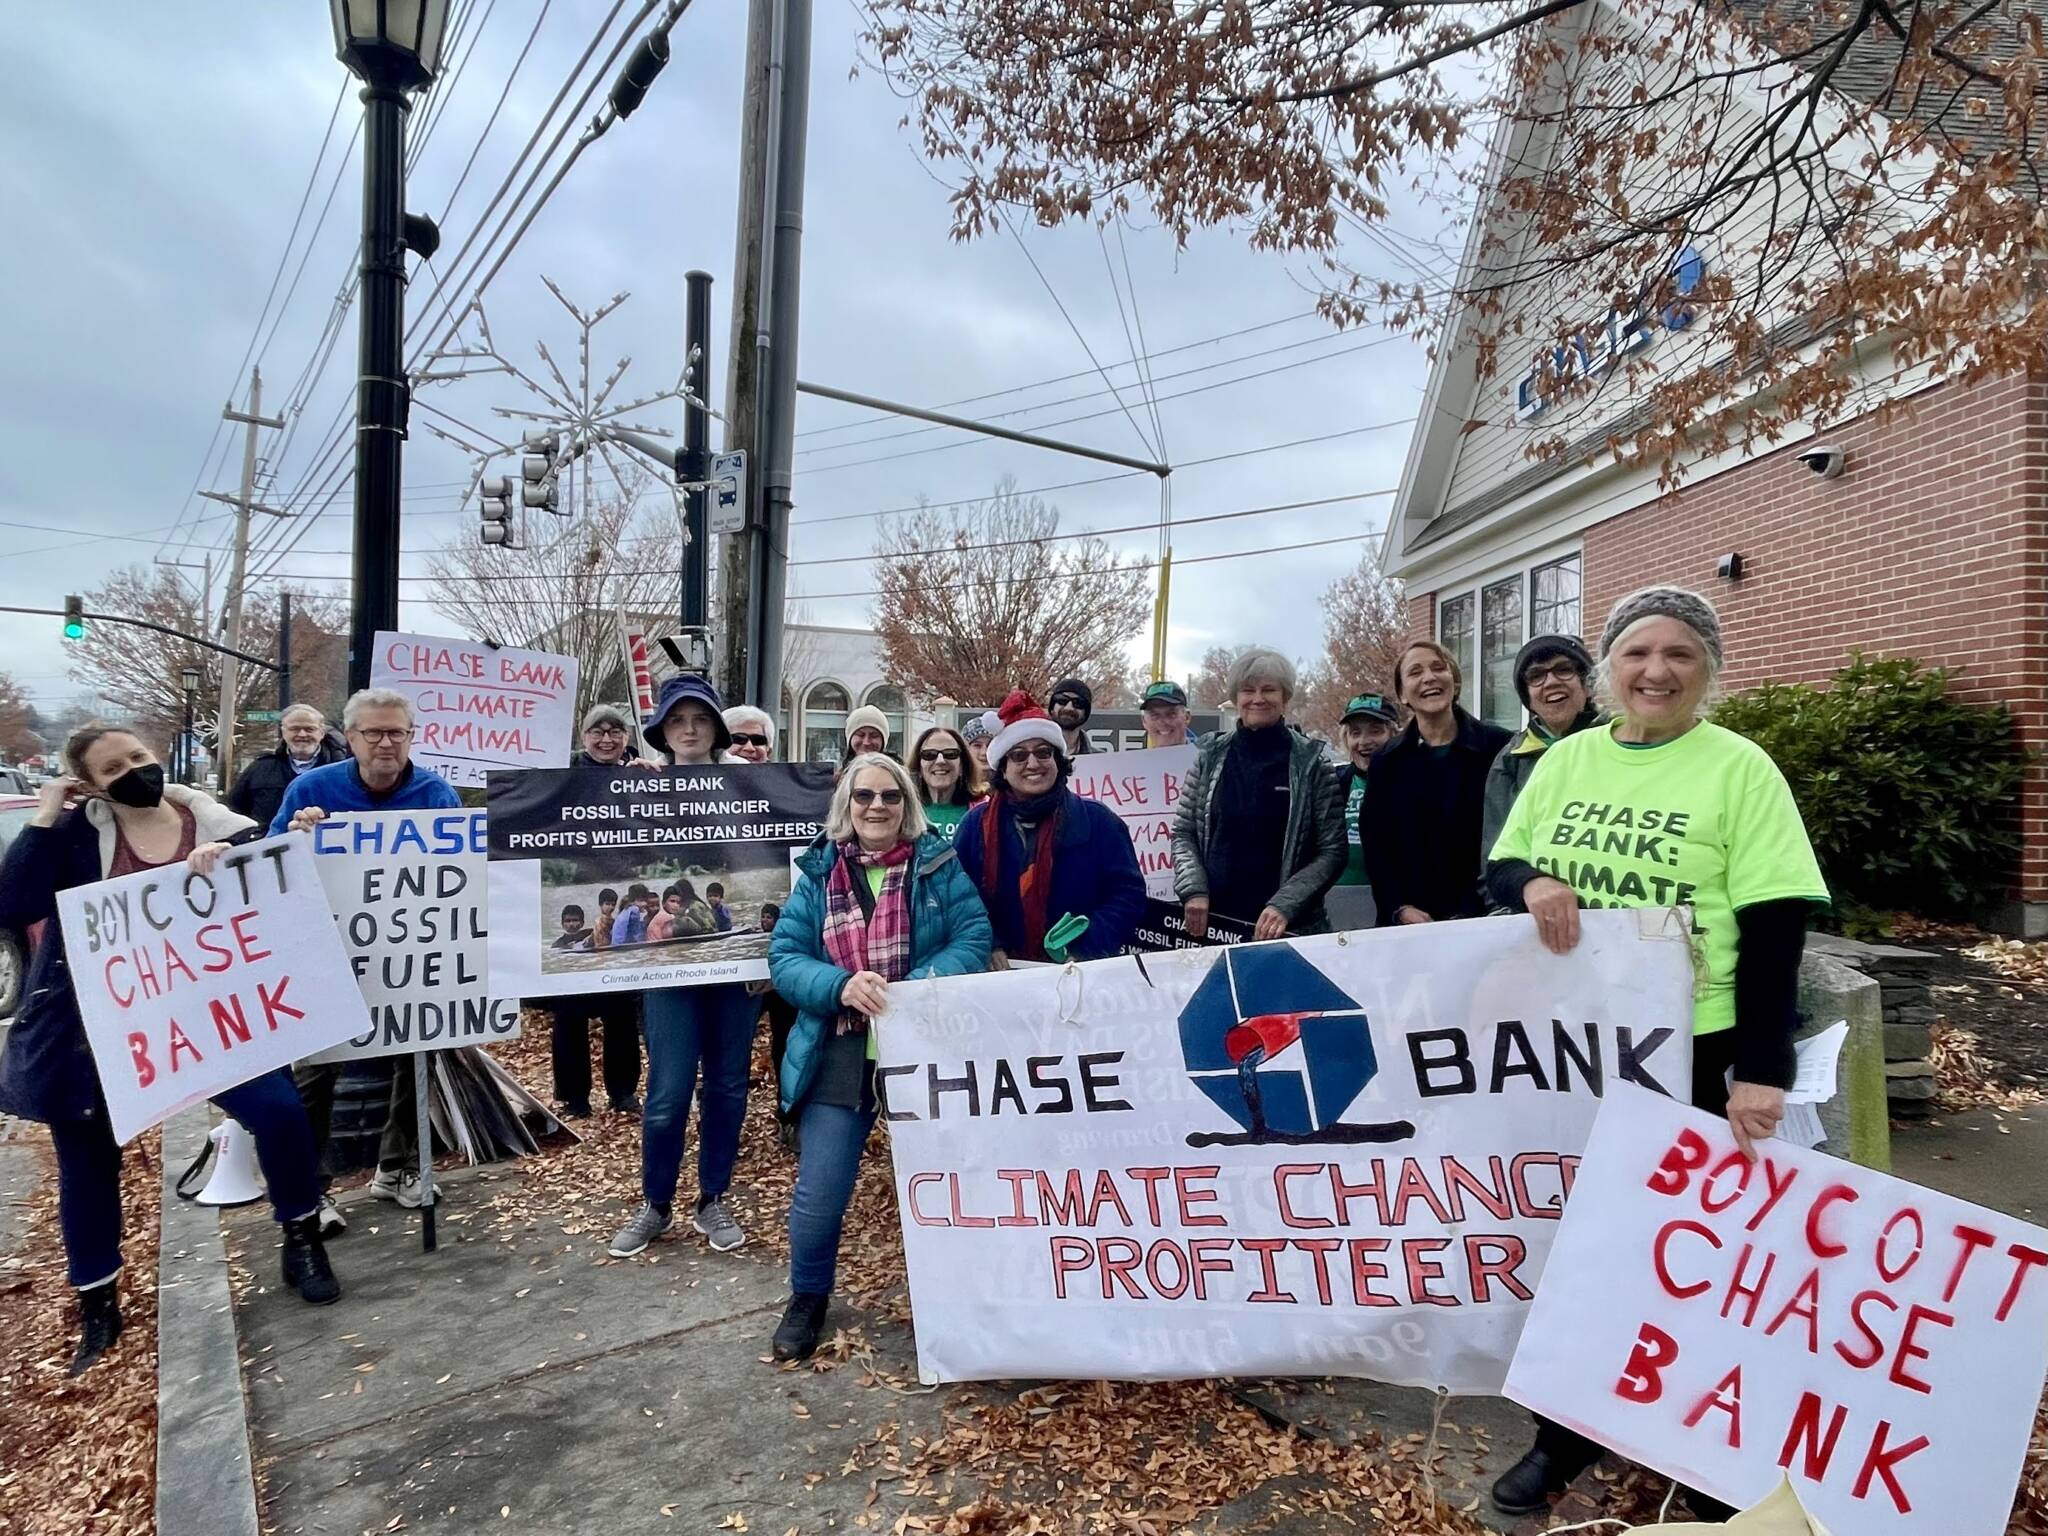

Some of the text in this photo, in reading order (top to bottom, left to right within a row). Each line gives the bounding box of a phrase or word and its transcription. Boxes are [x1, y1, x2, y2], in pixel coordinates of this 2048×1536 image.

[386, 642, 566, 690] CHASE BANK
[416, 690, 537, 719] CLIMATE
[609, 777, 724, 794] CHASE BANK
[1075, 773, 1148, 806] HASE
[561, 799, 770, 821] FOSSIL FUEL FINANCIER
[1561, 801, 1690, 838] CHASE
[509, 822, 818, 849] PROFITS WHILE PAKISTAN SUFFERS
[1550, 824, 1679, 866] BANK:
[83, 843, 291, 953] BOYCOTT
[363, 865, 467, 903] END
[333, 906, 487, 947] OSSIL
[1135, 928, 1203, 950] OSSIL FUE
[1164, 916, 1243, 944] CHA BANK
[105, 910, 272, 1008] CHASE
[350, 952, 477, 989] FUEL
[601, 966, 739, 985] Climate Action Rhode Island
[128, 976, 306, 1088] BANK
[350, 997, 518, 1048] UNDING
[878, 1019, 1676, 1122] CHASE BANK
[908, 1166, 1229, 1228] CLIMATE
[1645, 1127, 2048, 1322] BOYCOTT
[1050, 1234, 1535, 1307] PROFITEER
[1653, 1219, 1955, 1394] CHASE
[1614, 1321, 1930, 1514] BANK
